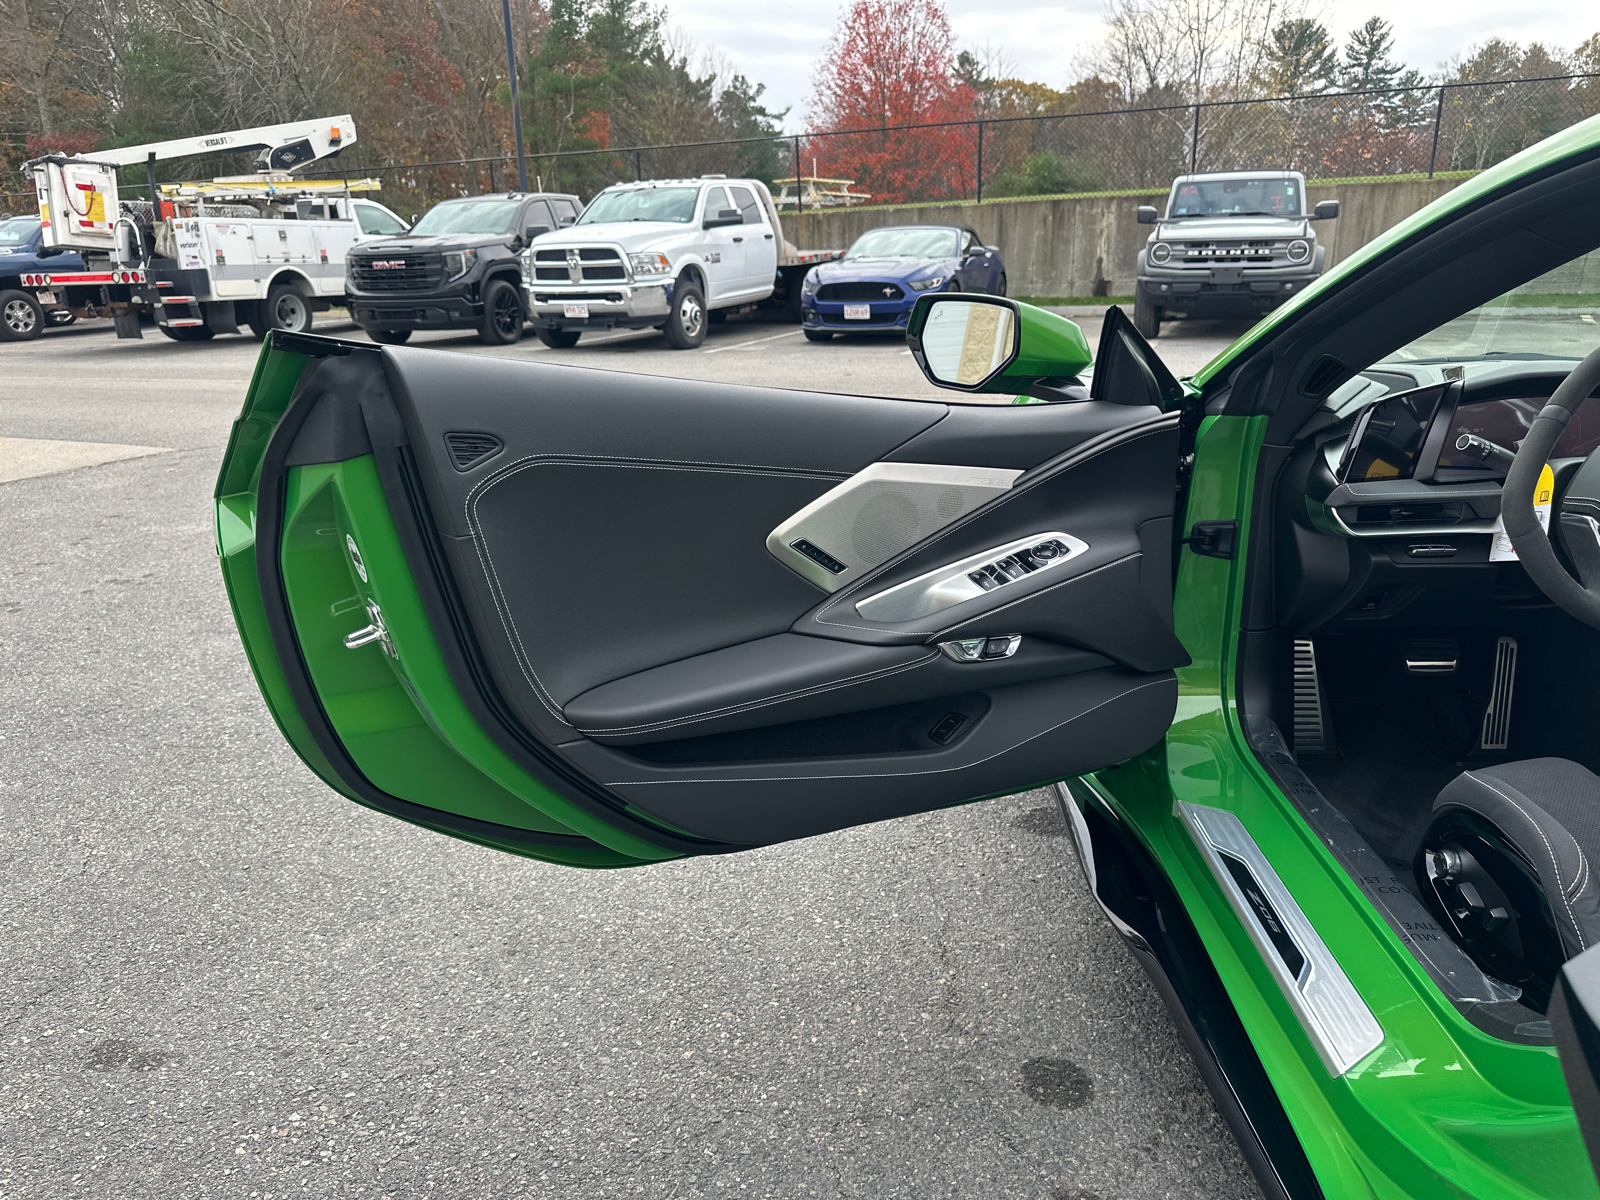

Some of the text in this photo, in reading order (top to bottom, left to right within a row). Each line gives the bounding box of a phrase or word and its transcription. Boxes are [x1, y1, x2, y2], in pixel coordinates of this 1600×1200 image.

[204, 137, 228, 147] VERSALIFT
[180, 241, 198, 249] verizon
[1187, 248, 1270, 257] BRONCO
[372, 260, 406, 270] GMC
[1246, 888, 1281, 934] Z06
